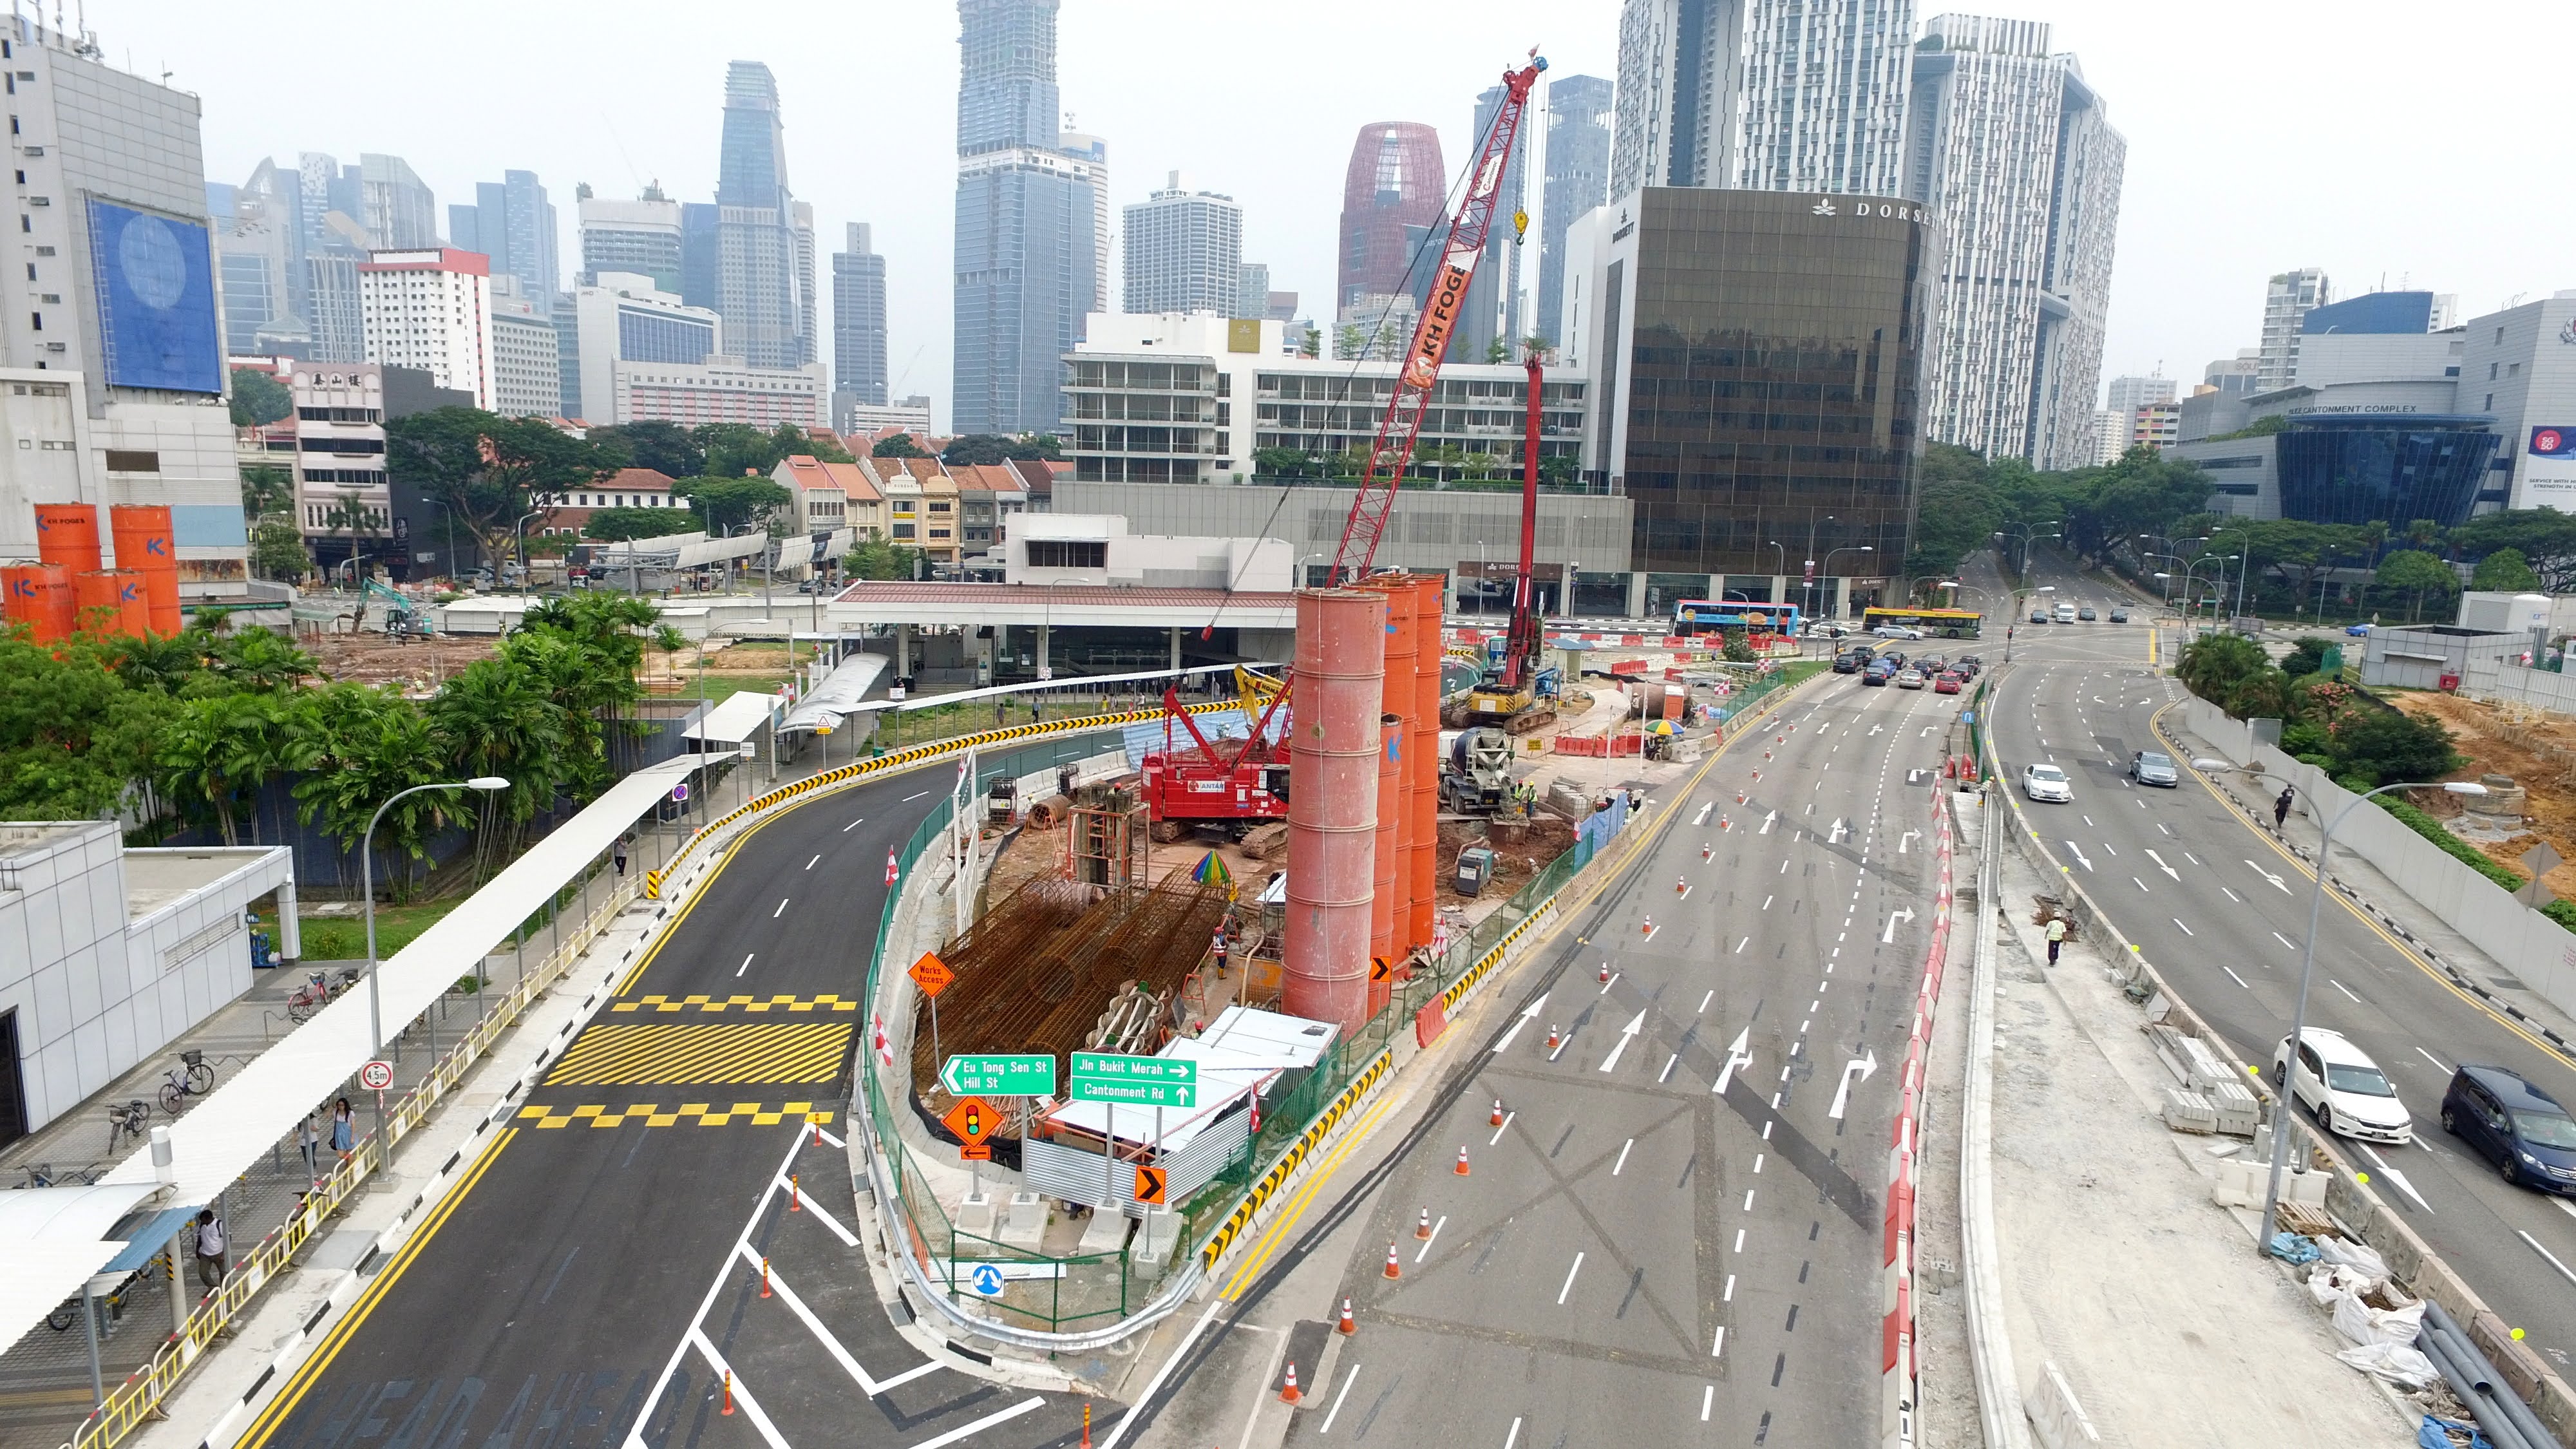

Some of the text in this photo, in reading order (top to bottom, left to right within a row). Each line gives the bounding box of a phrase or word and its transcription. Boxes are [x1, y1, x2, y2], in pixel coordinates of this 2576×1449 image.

[1421, 324, 1443, 357] KH
[2303, 405, 2362, 413] CANTONMENT
[919, 965, 942, 975] Works
[919, 974, 943, 984] Access
[963, 1061, 1047, 1075] Eu Tong Sen St
[1079, 1059, 1163, 1075] Jln Bukit Merah
[367, 1070, 388, 1080] 4.5m
[963, 1077, 998, 1088] Hill St
[1084, 1083, 1164, 1099] Cantonment Rd
